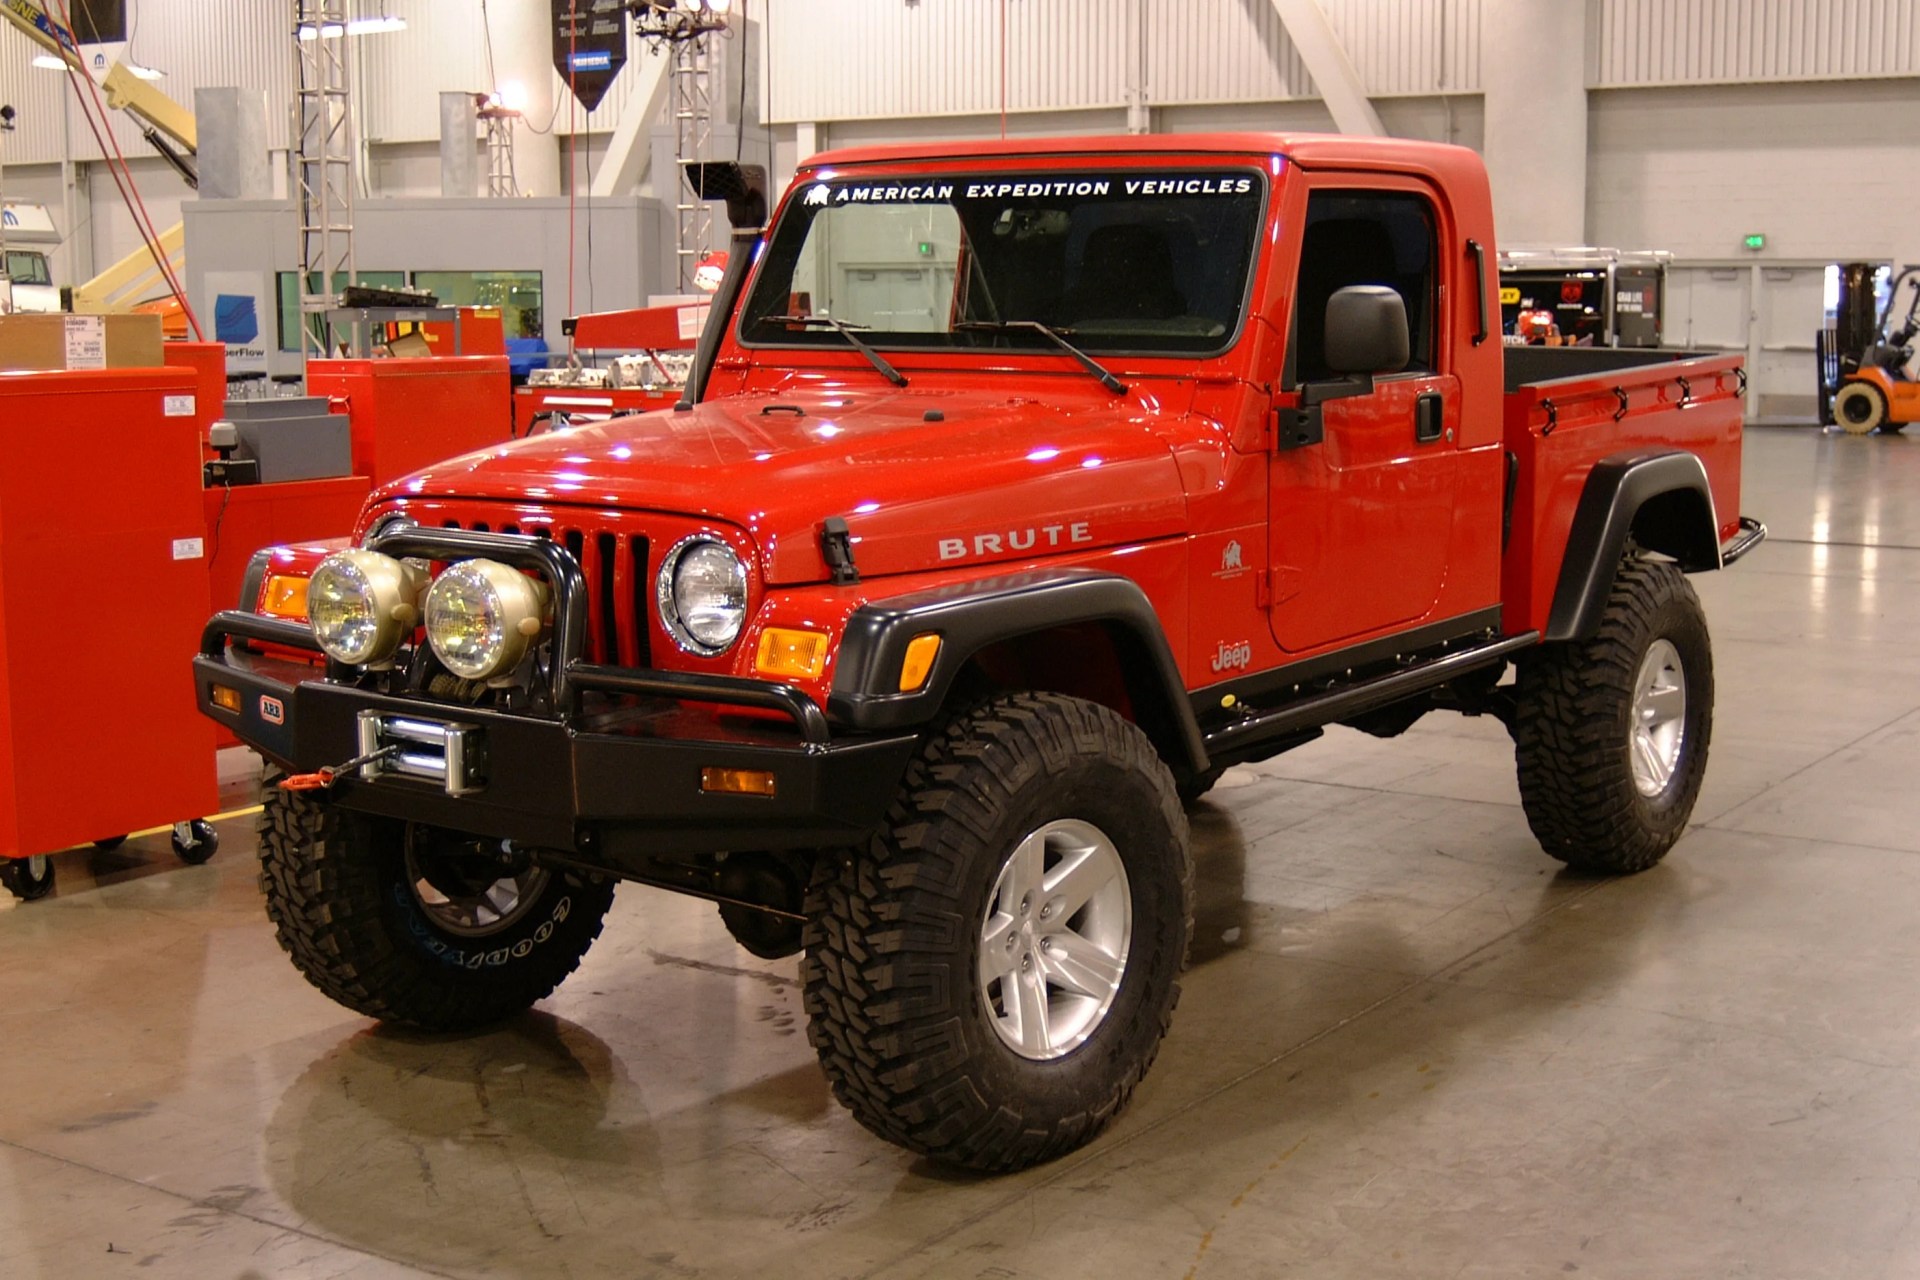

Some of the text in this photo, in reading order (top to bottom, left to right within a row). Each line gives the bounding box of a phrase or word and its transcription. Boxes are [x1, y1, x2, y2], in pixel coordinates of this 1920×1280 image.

[835, 179, 1252, 201] AMERICAN EXPEDITION VEHICLES
[938, 522, 1093, 560] BRUTE
[1211, 641, 1250, 672] Jeep
